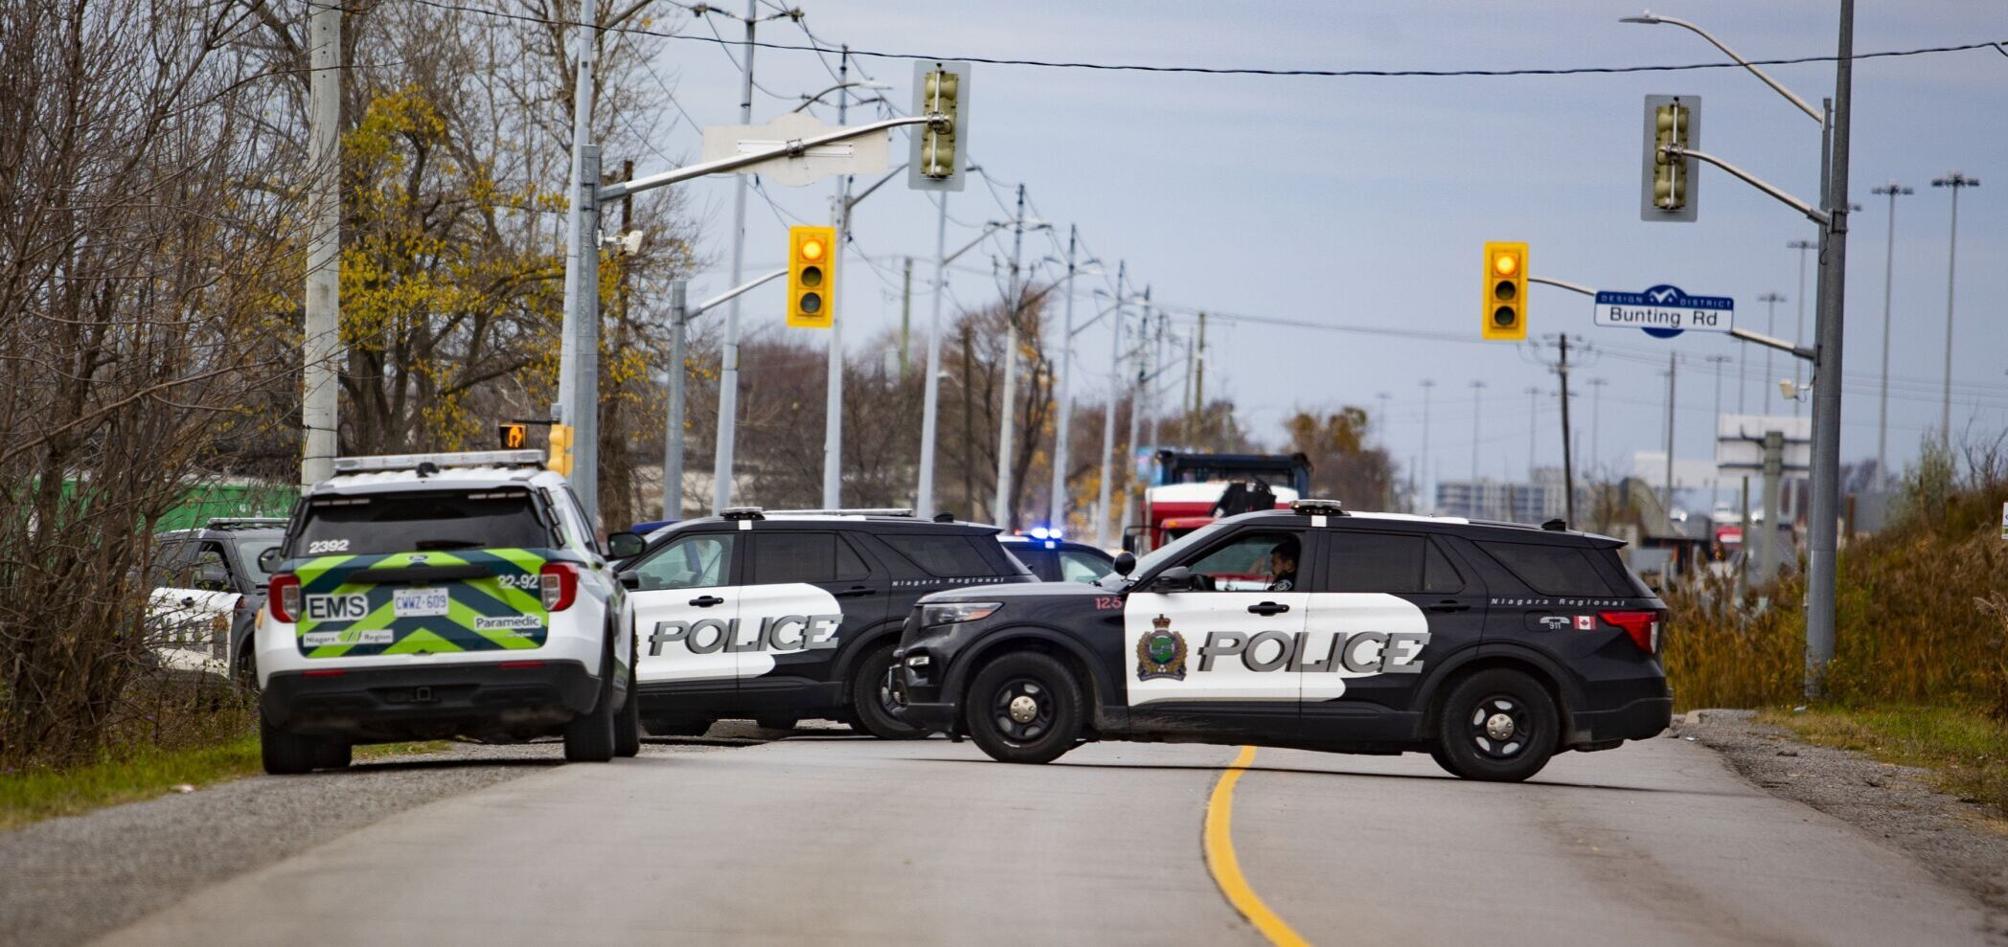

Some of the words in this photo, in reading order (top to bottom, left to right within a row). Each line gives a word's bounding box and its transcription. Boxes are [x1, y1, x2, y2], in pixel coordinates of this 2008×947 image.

[1601, 294, 1643, 303] DESIGN
[1679, 299, 1732, 308] DISTRICT
[1610, 307, 1681, 328] Bunting
[1693, 311, 1717, 326] Rd
[309, 540, 349, 553] 2392
[497, 574, 539, 589] 22-92
[309, 596, 365, 618] EMS
[1491, 598, 1549, 606] Niagara
[1559, 598, 1625, 606] Regional
[476, 616, 539, 628] Paramedic
[1549, 622, 1561, 630] 911
[648, 614, 844, 656] POLICE
[1197, 630, 1432, 673] POLICE
